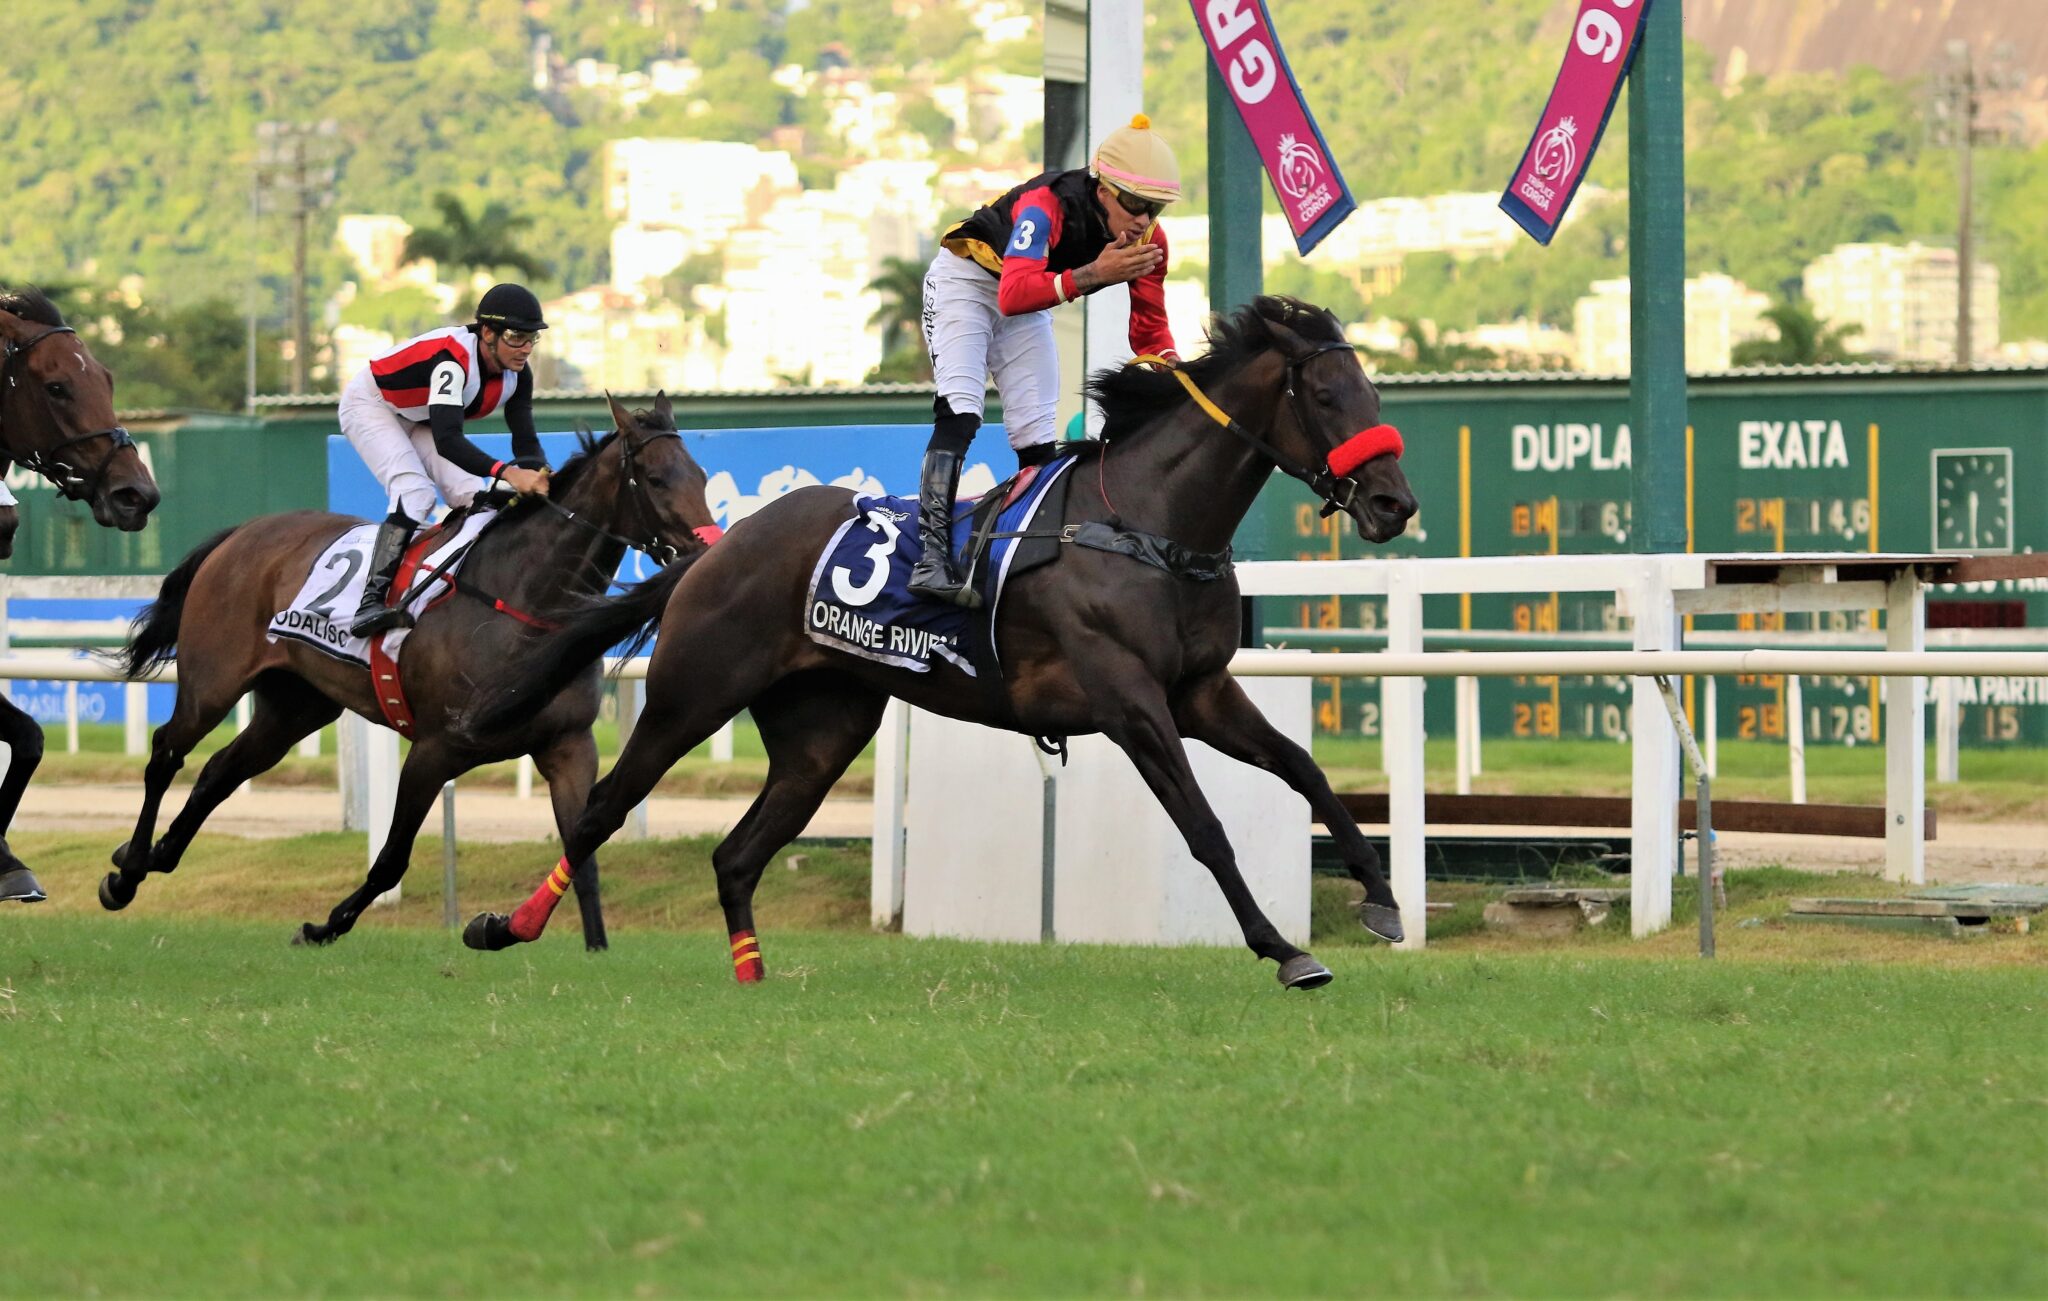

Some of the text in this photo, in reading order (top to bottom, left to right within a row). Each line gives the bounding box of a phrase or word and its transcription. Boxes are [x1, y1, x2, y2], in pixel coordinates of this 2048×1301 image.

[1300, 192, 1333, 222] COROA
[1521, 182, 1550, 212] COROA
[1013, 220, 1036, 250] 3
[437, 370, 455, 395] 2
[1512, 424, 1632, 471] DUPLA
[1739, 420, 1849, 469] EXATA
[832, 511, 901, 606] 3
[303, 549, 363, 618] 2
[812, 600, 885, 649] ORANGE
